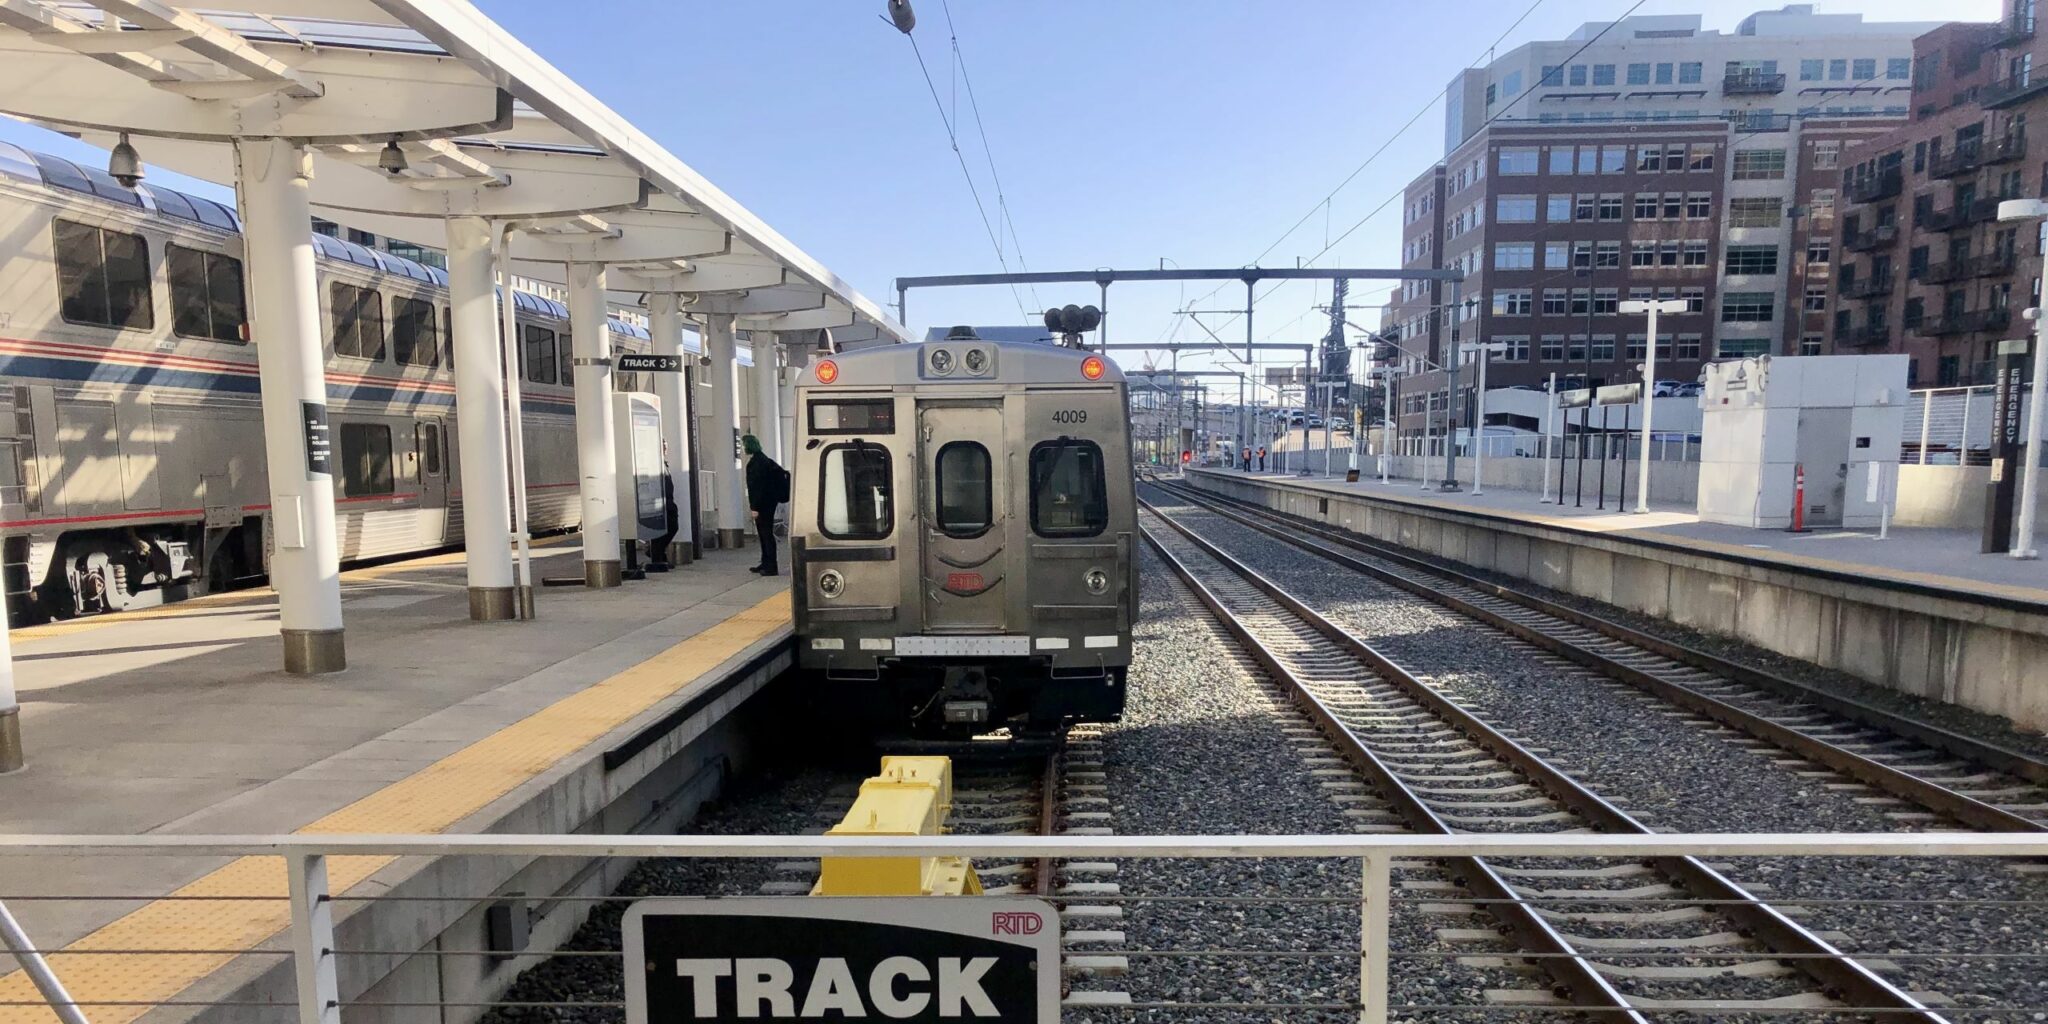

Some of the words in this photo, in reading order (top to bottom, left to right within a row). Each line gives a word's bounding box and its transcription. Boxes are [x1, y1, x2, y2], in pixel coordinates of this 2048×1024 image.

[624, 358, 656, 368] TRACK
[659, 358, 667, 369] 3
[1052, 410, 1087, 424] 4009
[1993, 368, 2004, 443] EMERGENCY
[2006, 367, 2020, 443] EMERGENCY
[992, 912, 1043, 935] RTD
[676, 956, 1002, 1018] TRACK
